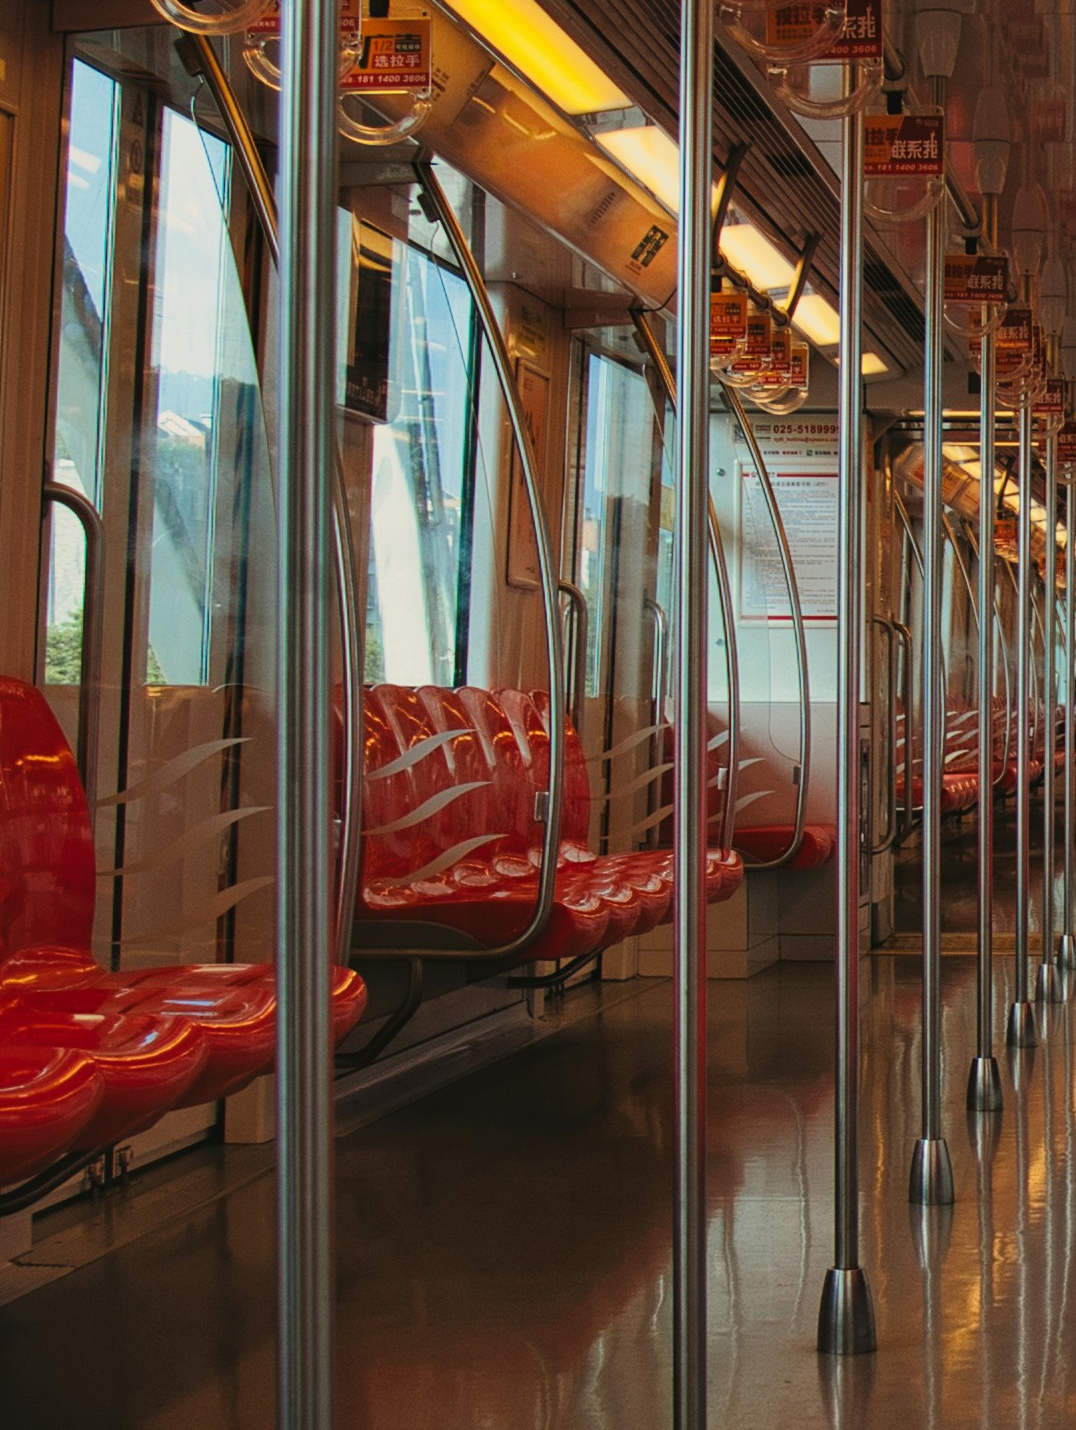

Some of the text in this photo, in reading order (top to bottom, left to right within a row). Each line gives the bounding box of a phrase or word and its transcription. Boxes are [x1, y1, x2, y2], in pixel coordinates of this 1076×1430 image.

[852, 45, 877, 53] 3606
[374, 55, 420, 68] 选拉手
[358, 75, 374, 83] 181
[378, 74, 400, 83] 1400
[403, 74, 426, 82] 3606
[891, 130, 938, 159] 联系我
[896, 163, 916, 171] 1400
[773, 425, 839, 434] 025-518999
